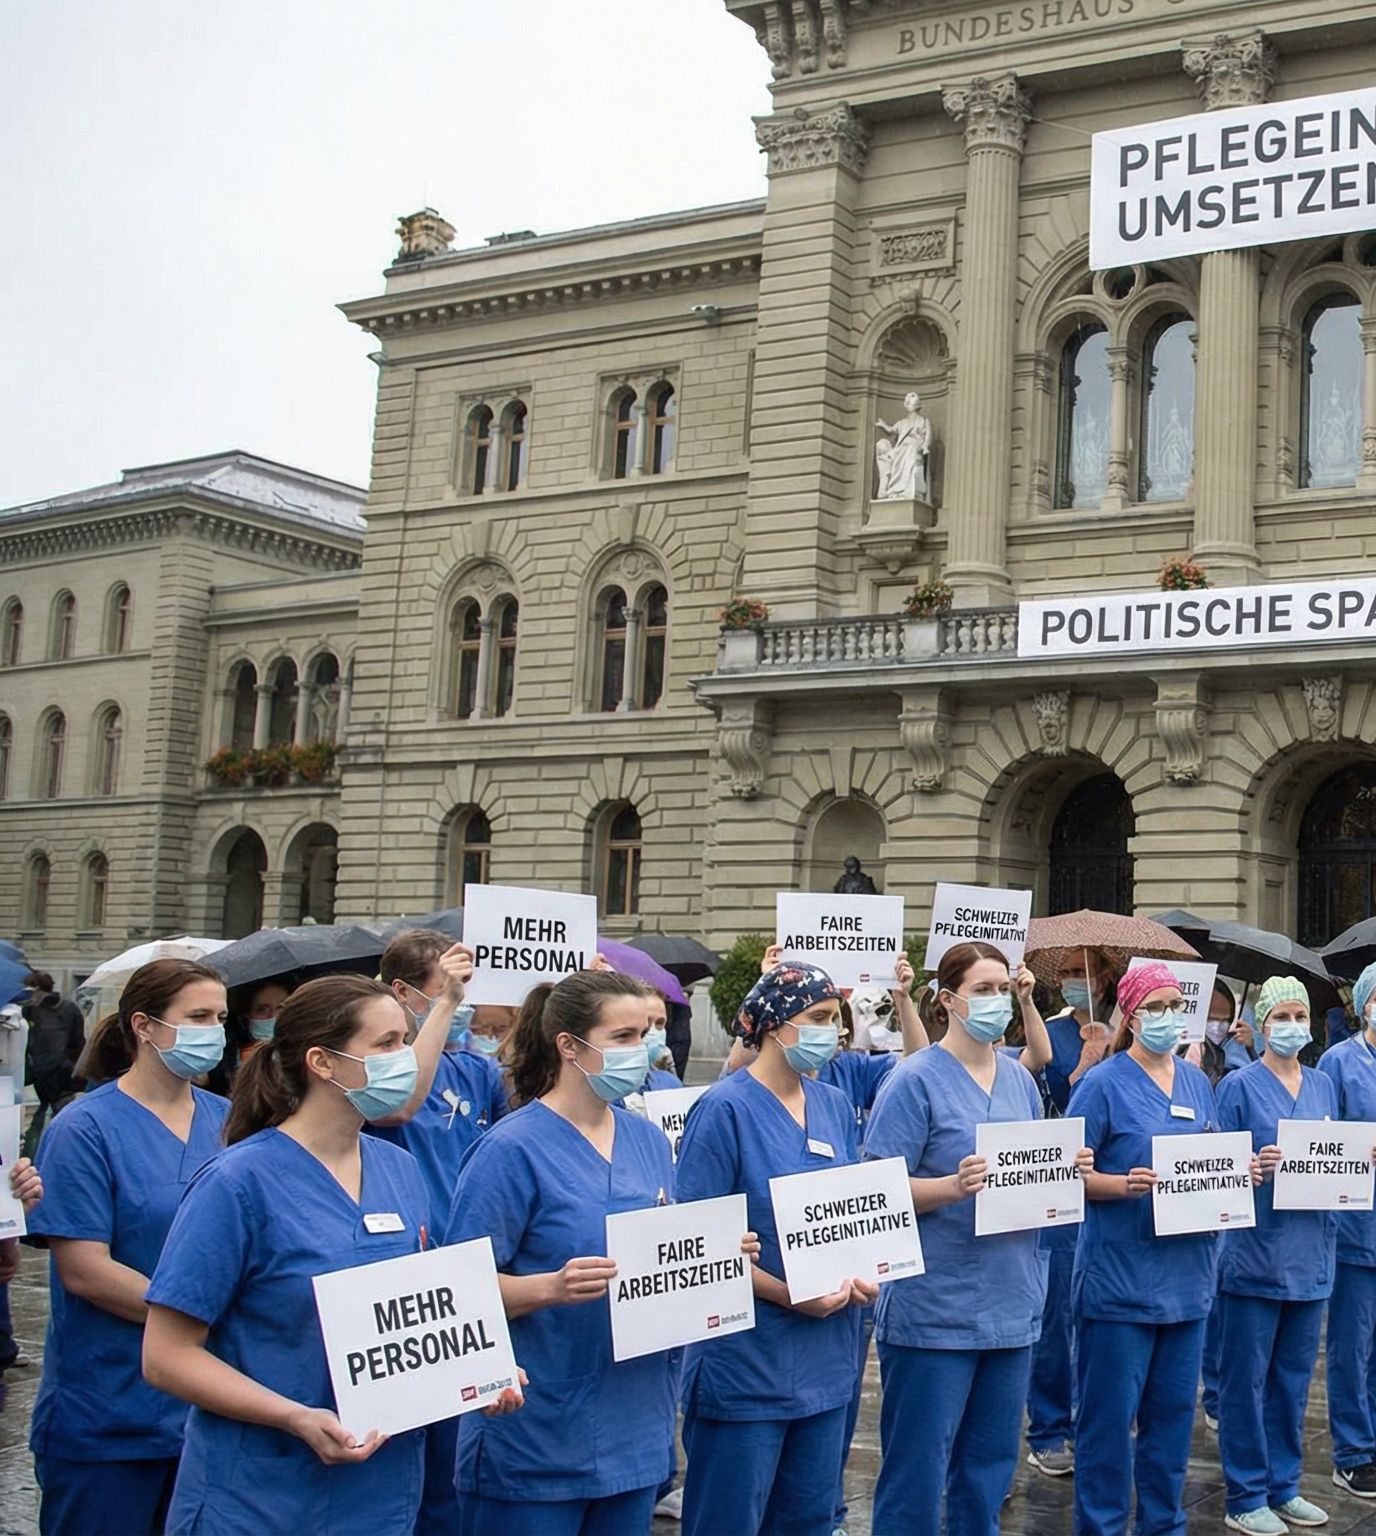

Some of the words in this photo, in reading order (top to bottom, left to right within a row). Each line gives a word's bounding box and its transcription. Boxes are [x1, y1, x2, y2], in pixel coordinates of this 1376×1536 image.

[897, 0, 1134, 54] BUNDESHAUS
[1041, 593, 1293, 646] POLITISCHE
[503, 916, 566, 943] MEHR
[821, 916, 863, 932] FAIRE
[784, 935, 896, 952] ARBEITSZEITEN
[475, 945, 588, 972] PERSONAL
[1309, 1142, 1344, 1156] FAIRE
[982, 1165, 1079, 1189] FLEGEINITIATIVE
[1280, 1160, 1370, 1174] ARBEITSZEITEN
[804, 1193, 888, 1222] SCHWEIZER
[786, 1211, 911, 1250] PFLEGEINITIATIVE
[658, 1236, 705, 1265] FAIRE
[617, 1257, 744, 1302] ARBEITSZEITEN
[373, 1286, 457, 1334] MEHR
[346, 1319, 495, 1386] PERSONAL
